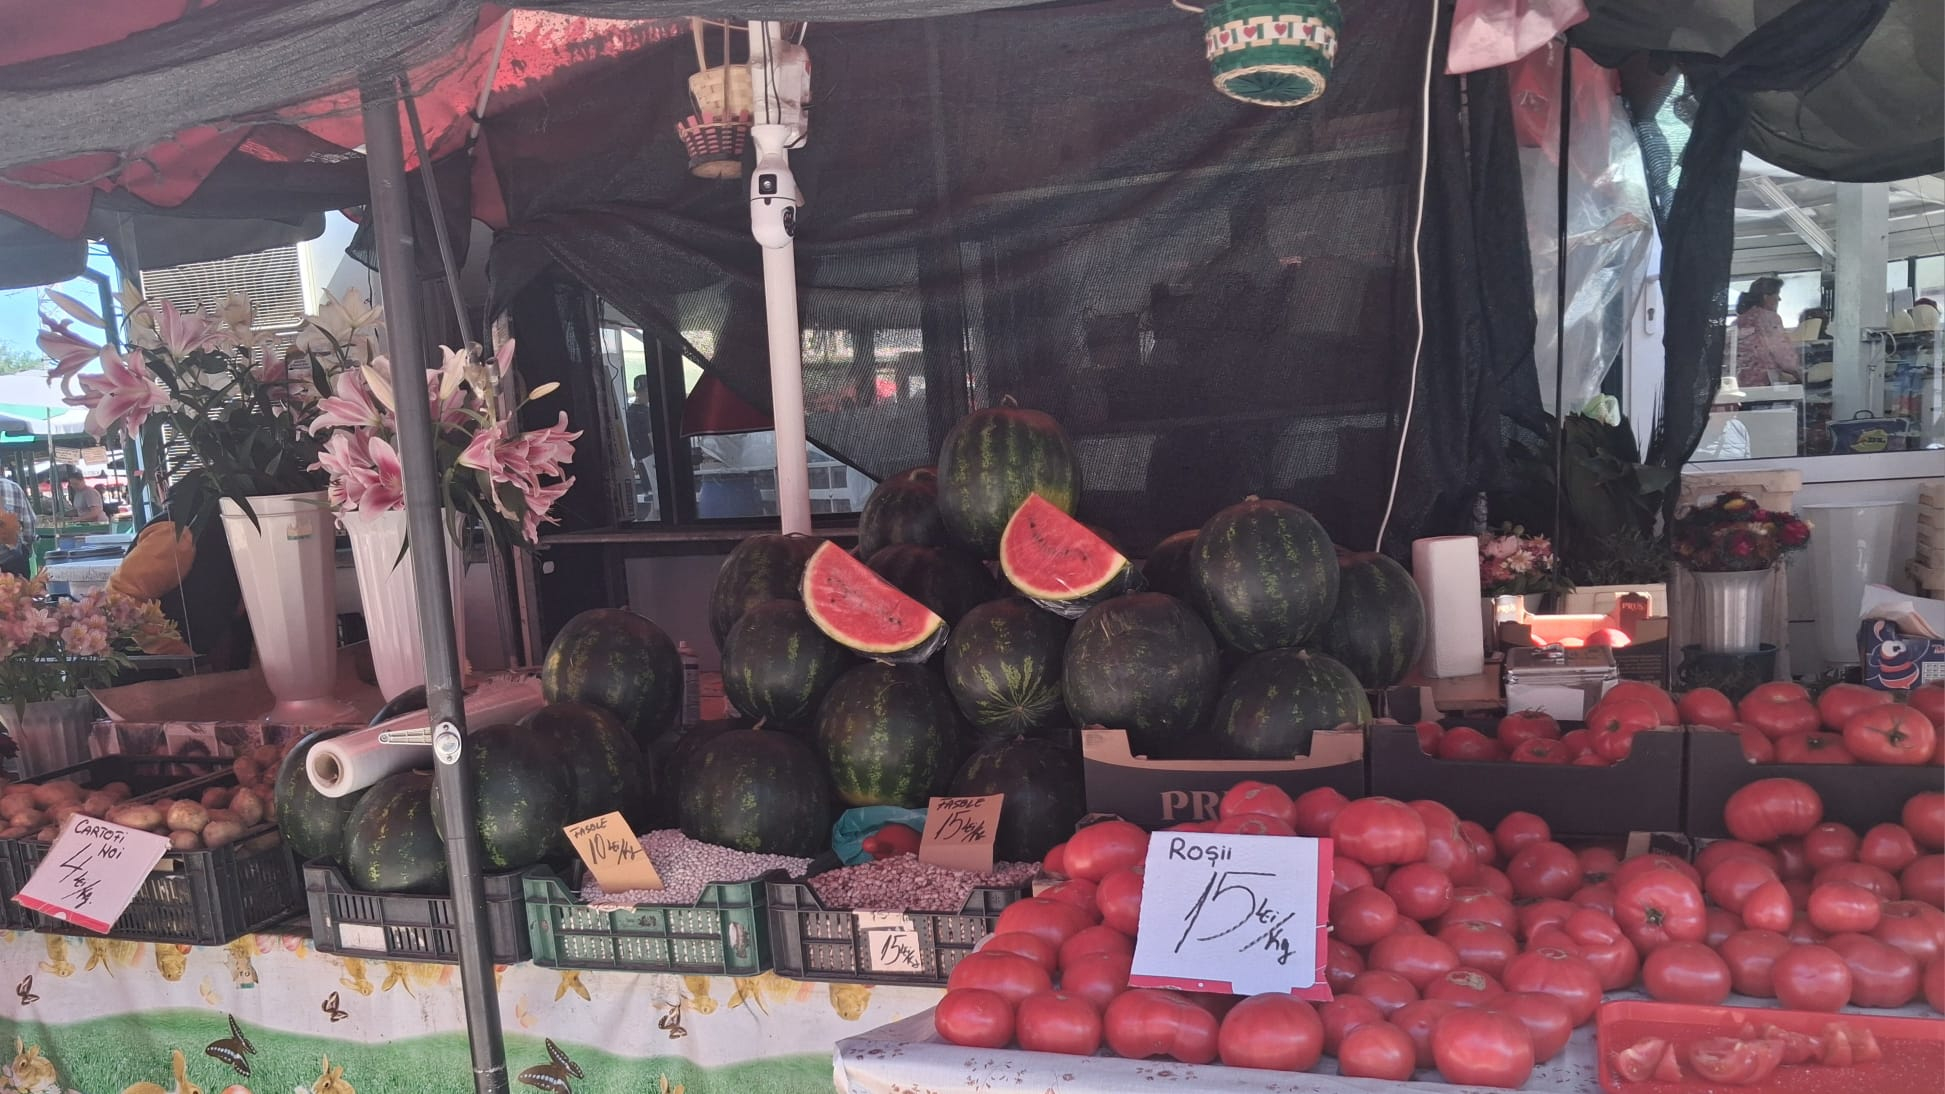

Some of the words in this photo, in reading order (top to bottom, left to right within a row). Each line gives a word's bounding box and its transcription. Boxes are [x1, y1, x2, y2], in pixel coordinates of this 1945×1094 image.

[1160, 790, 1228, 821] PR
[933, 809, 972, 840] 15
[59, 843, 93, 883] 4
[588, 833, 606, 865] 10
[1169, 837, 1232, 867] Roșii
[1174, 871, 1277, 953] 15
[880, 934, 907, 966] 15
